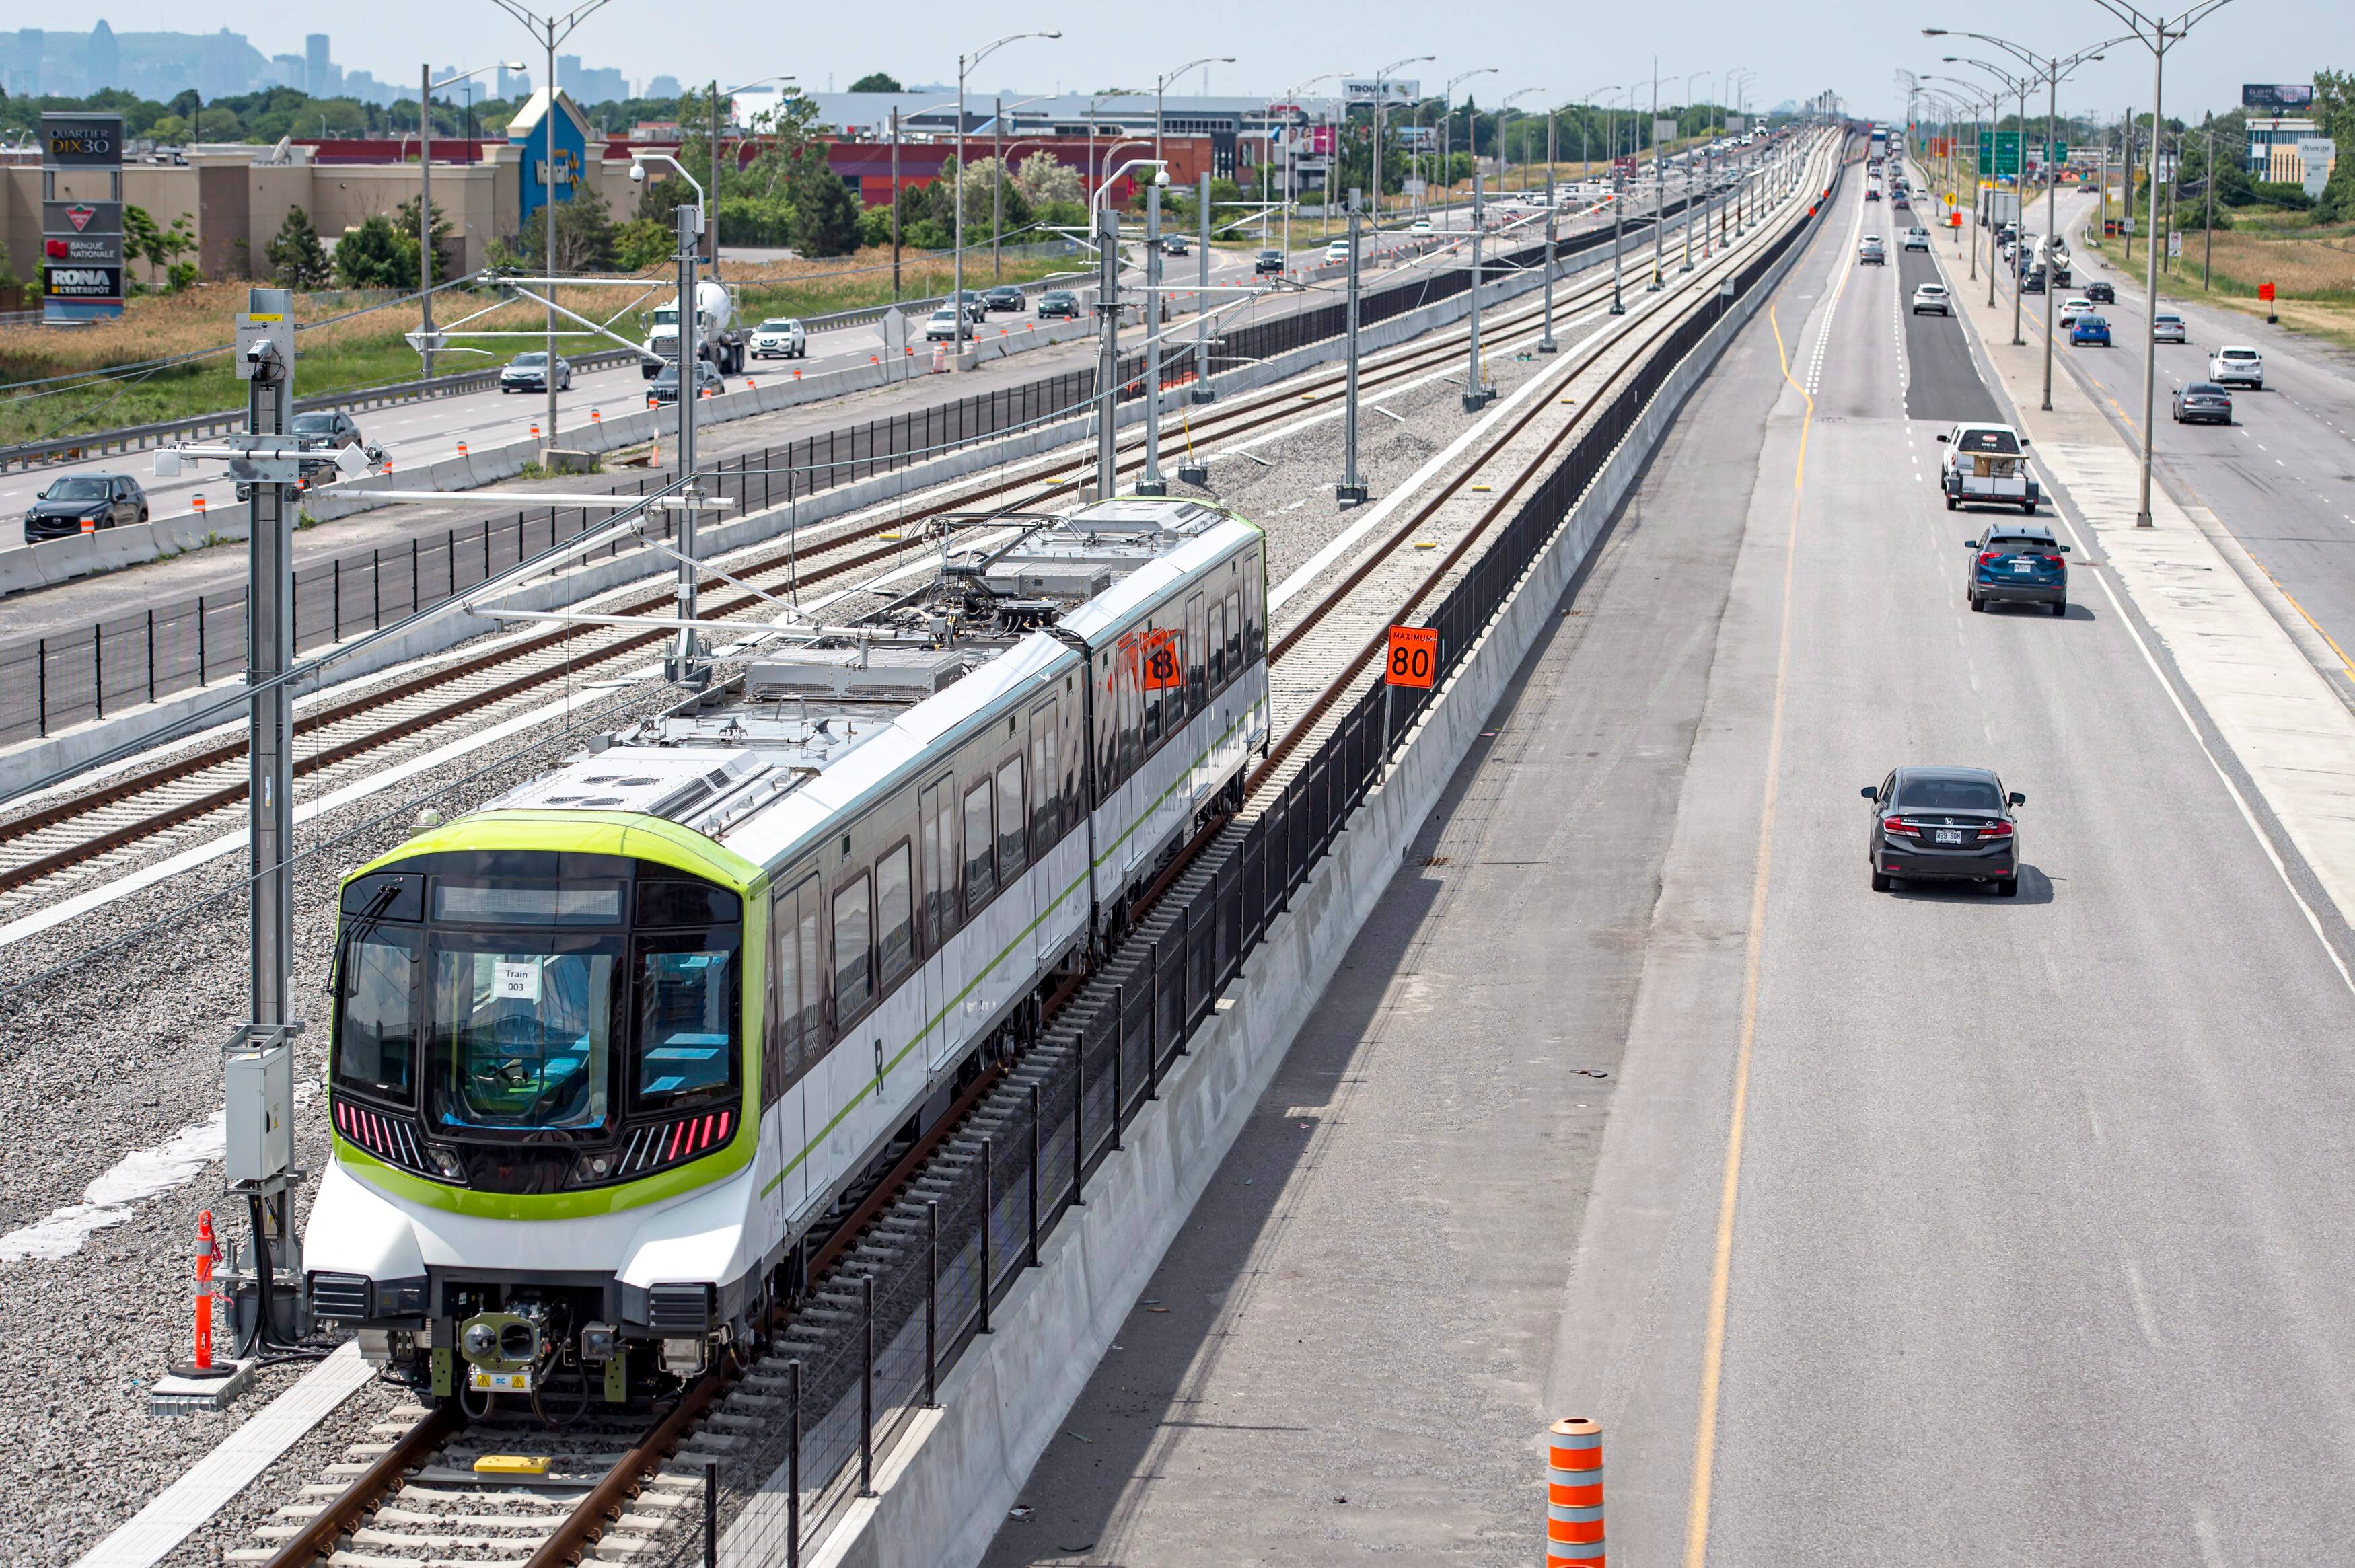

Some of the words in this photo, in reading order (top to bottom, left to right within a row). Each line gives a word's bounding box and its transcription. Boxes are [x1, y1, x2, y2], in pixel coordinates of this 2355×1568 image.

[1349, 83, 1389, 93] TROUÉ
[50, 130, 108, 139] QUARTIER
[50, 139, 109, 153] DIX30
[536, 159, 569, 184] Wamart
[52, 270, 110, 285] RONA
[59, 285, 110, 293] L'ENTREPÔT
[1393, 632, 1433, 642] MAXIMUM
[1392, 646, 1429, 678] 80
[506, 969, 528, 979] Train
[508, 983, 523, 991] 003
[875, 1038, 884, 1096] R
